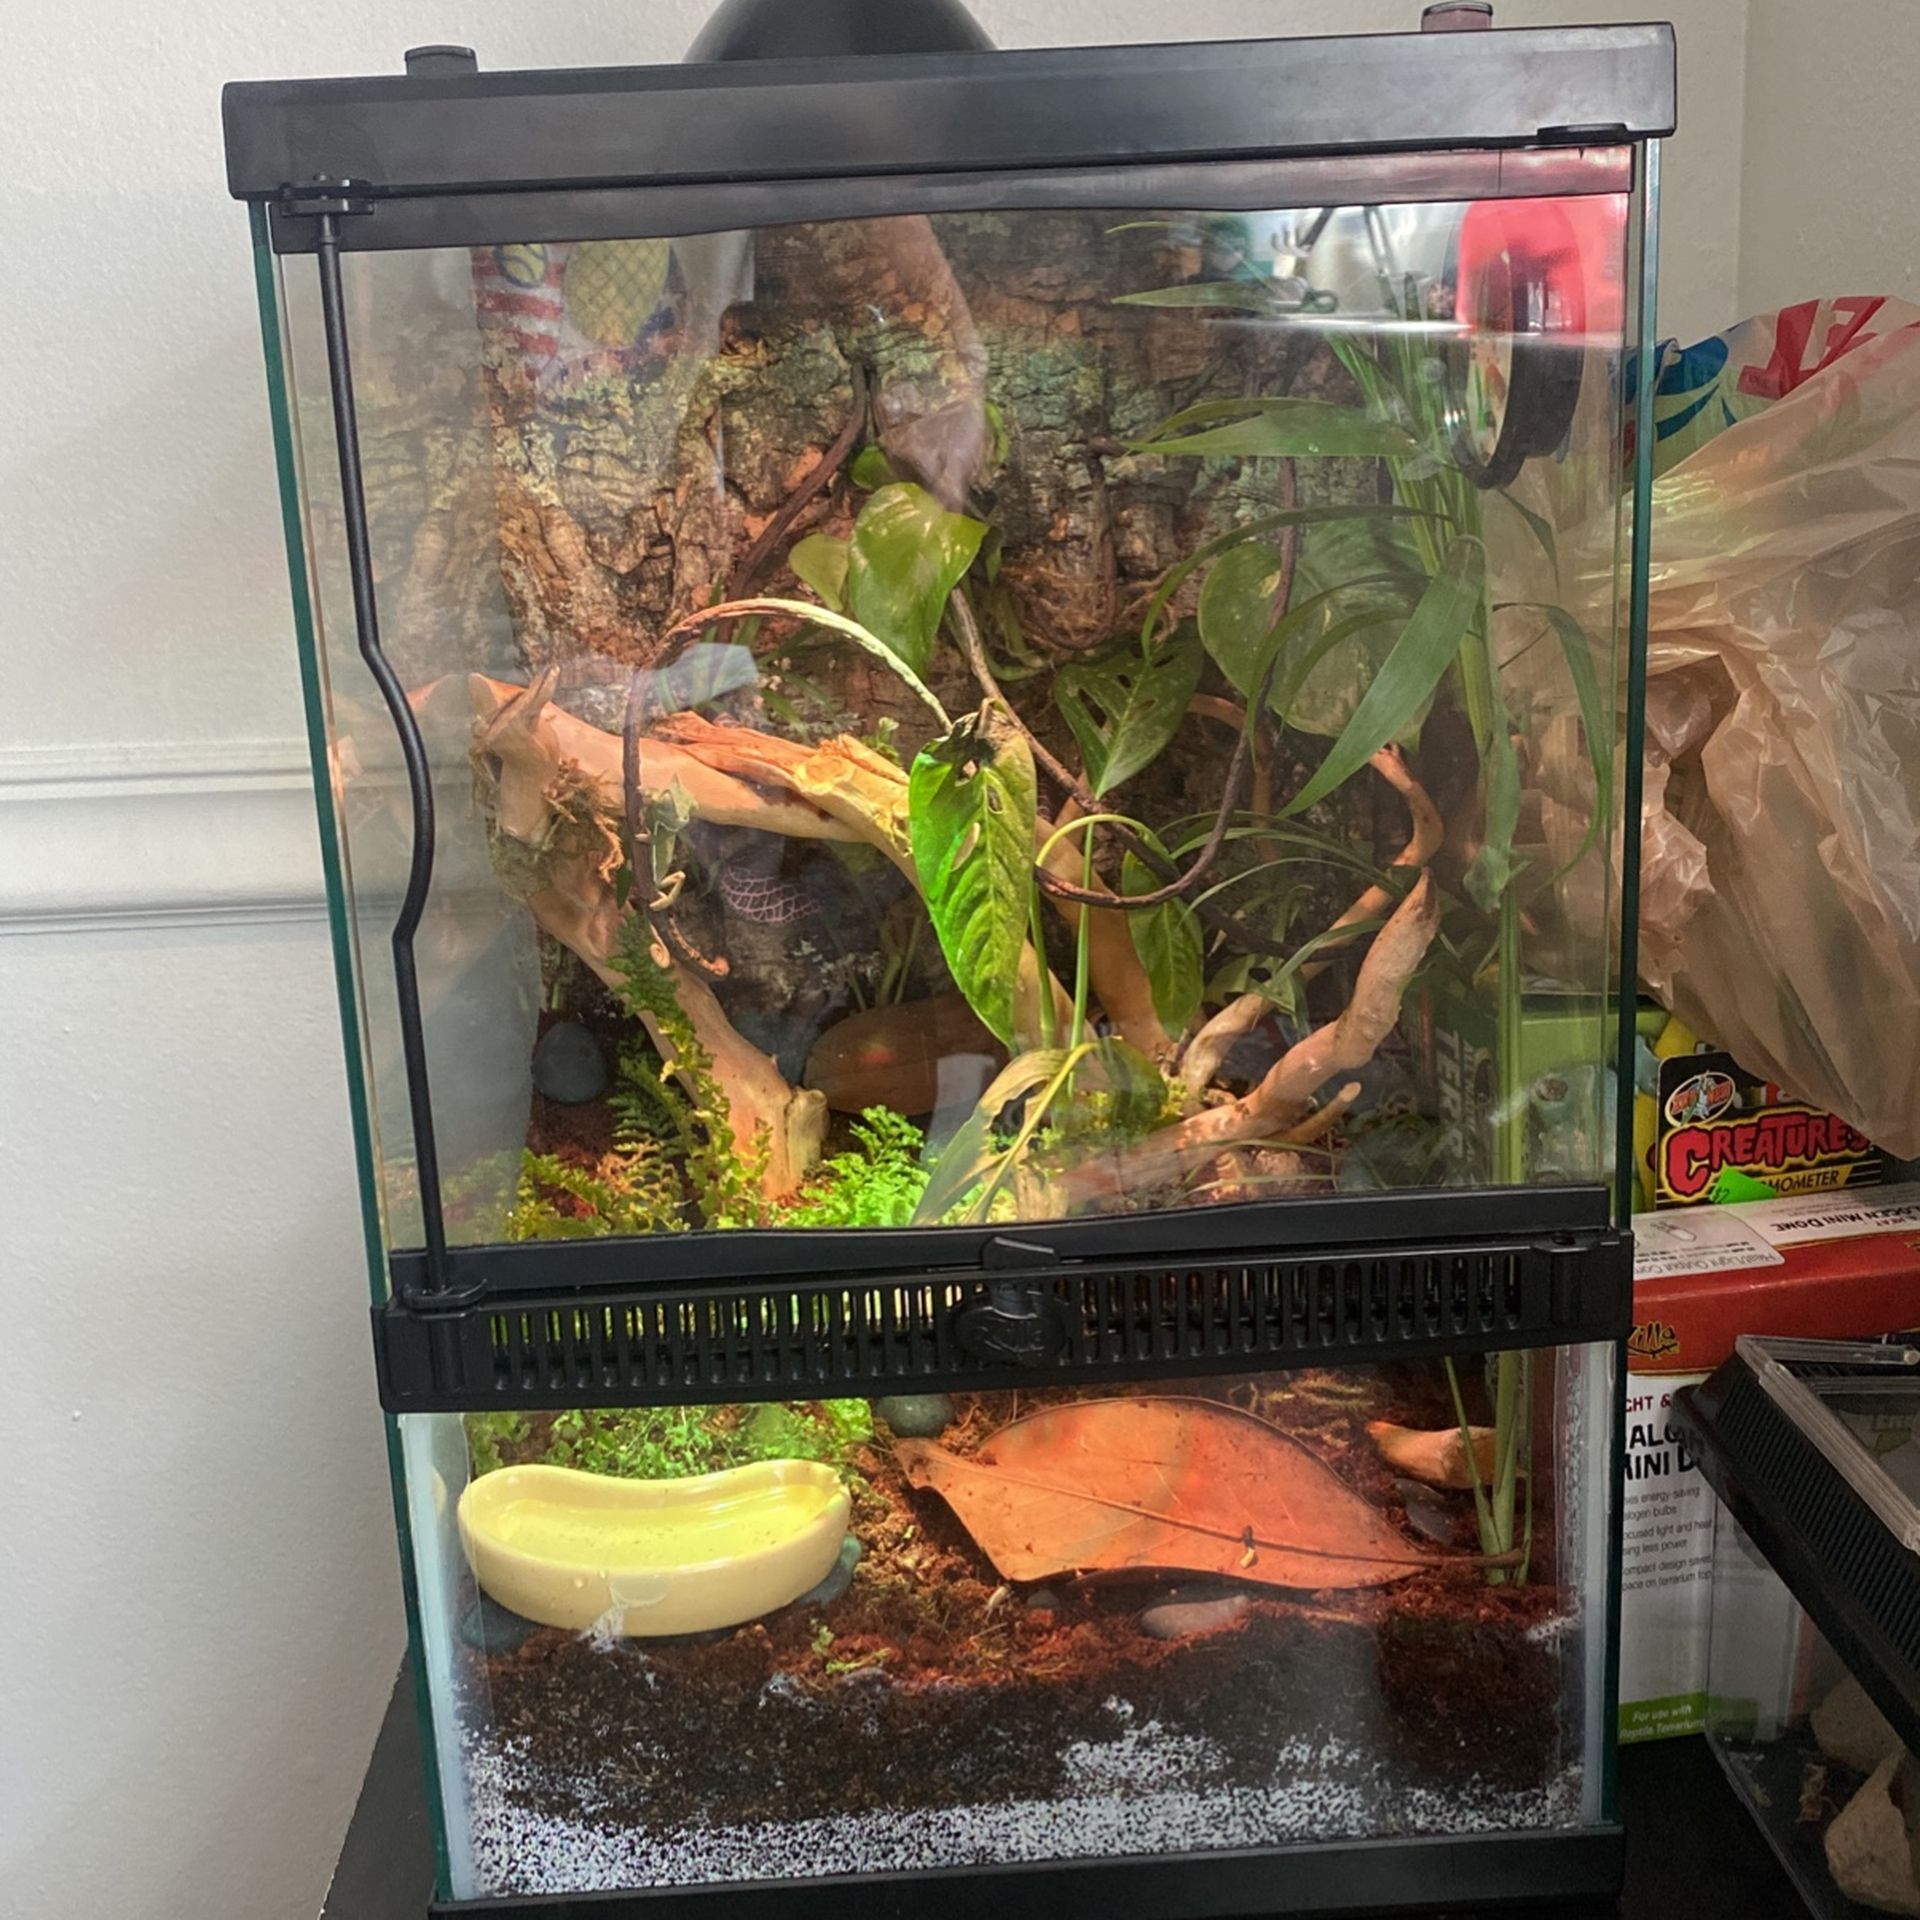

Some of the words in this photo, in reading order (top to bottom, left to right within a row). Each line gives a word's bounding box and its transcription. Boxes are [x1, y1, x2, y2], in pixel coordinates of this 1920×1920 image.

[1770, 1217, 1824, 1232] DOME
[1822, 1212, 1864, 1225] MINI
[1625, 1395, 1654, 1412] GHT
[1653, 1504, 1677, 1517] bulbs
[1656, 1524, 1674, 1537] light
[1676, 1522, 1693, 1534] and
[1645, 1578, 1657, 1588] on
